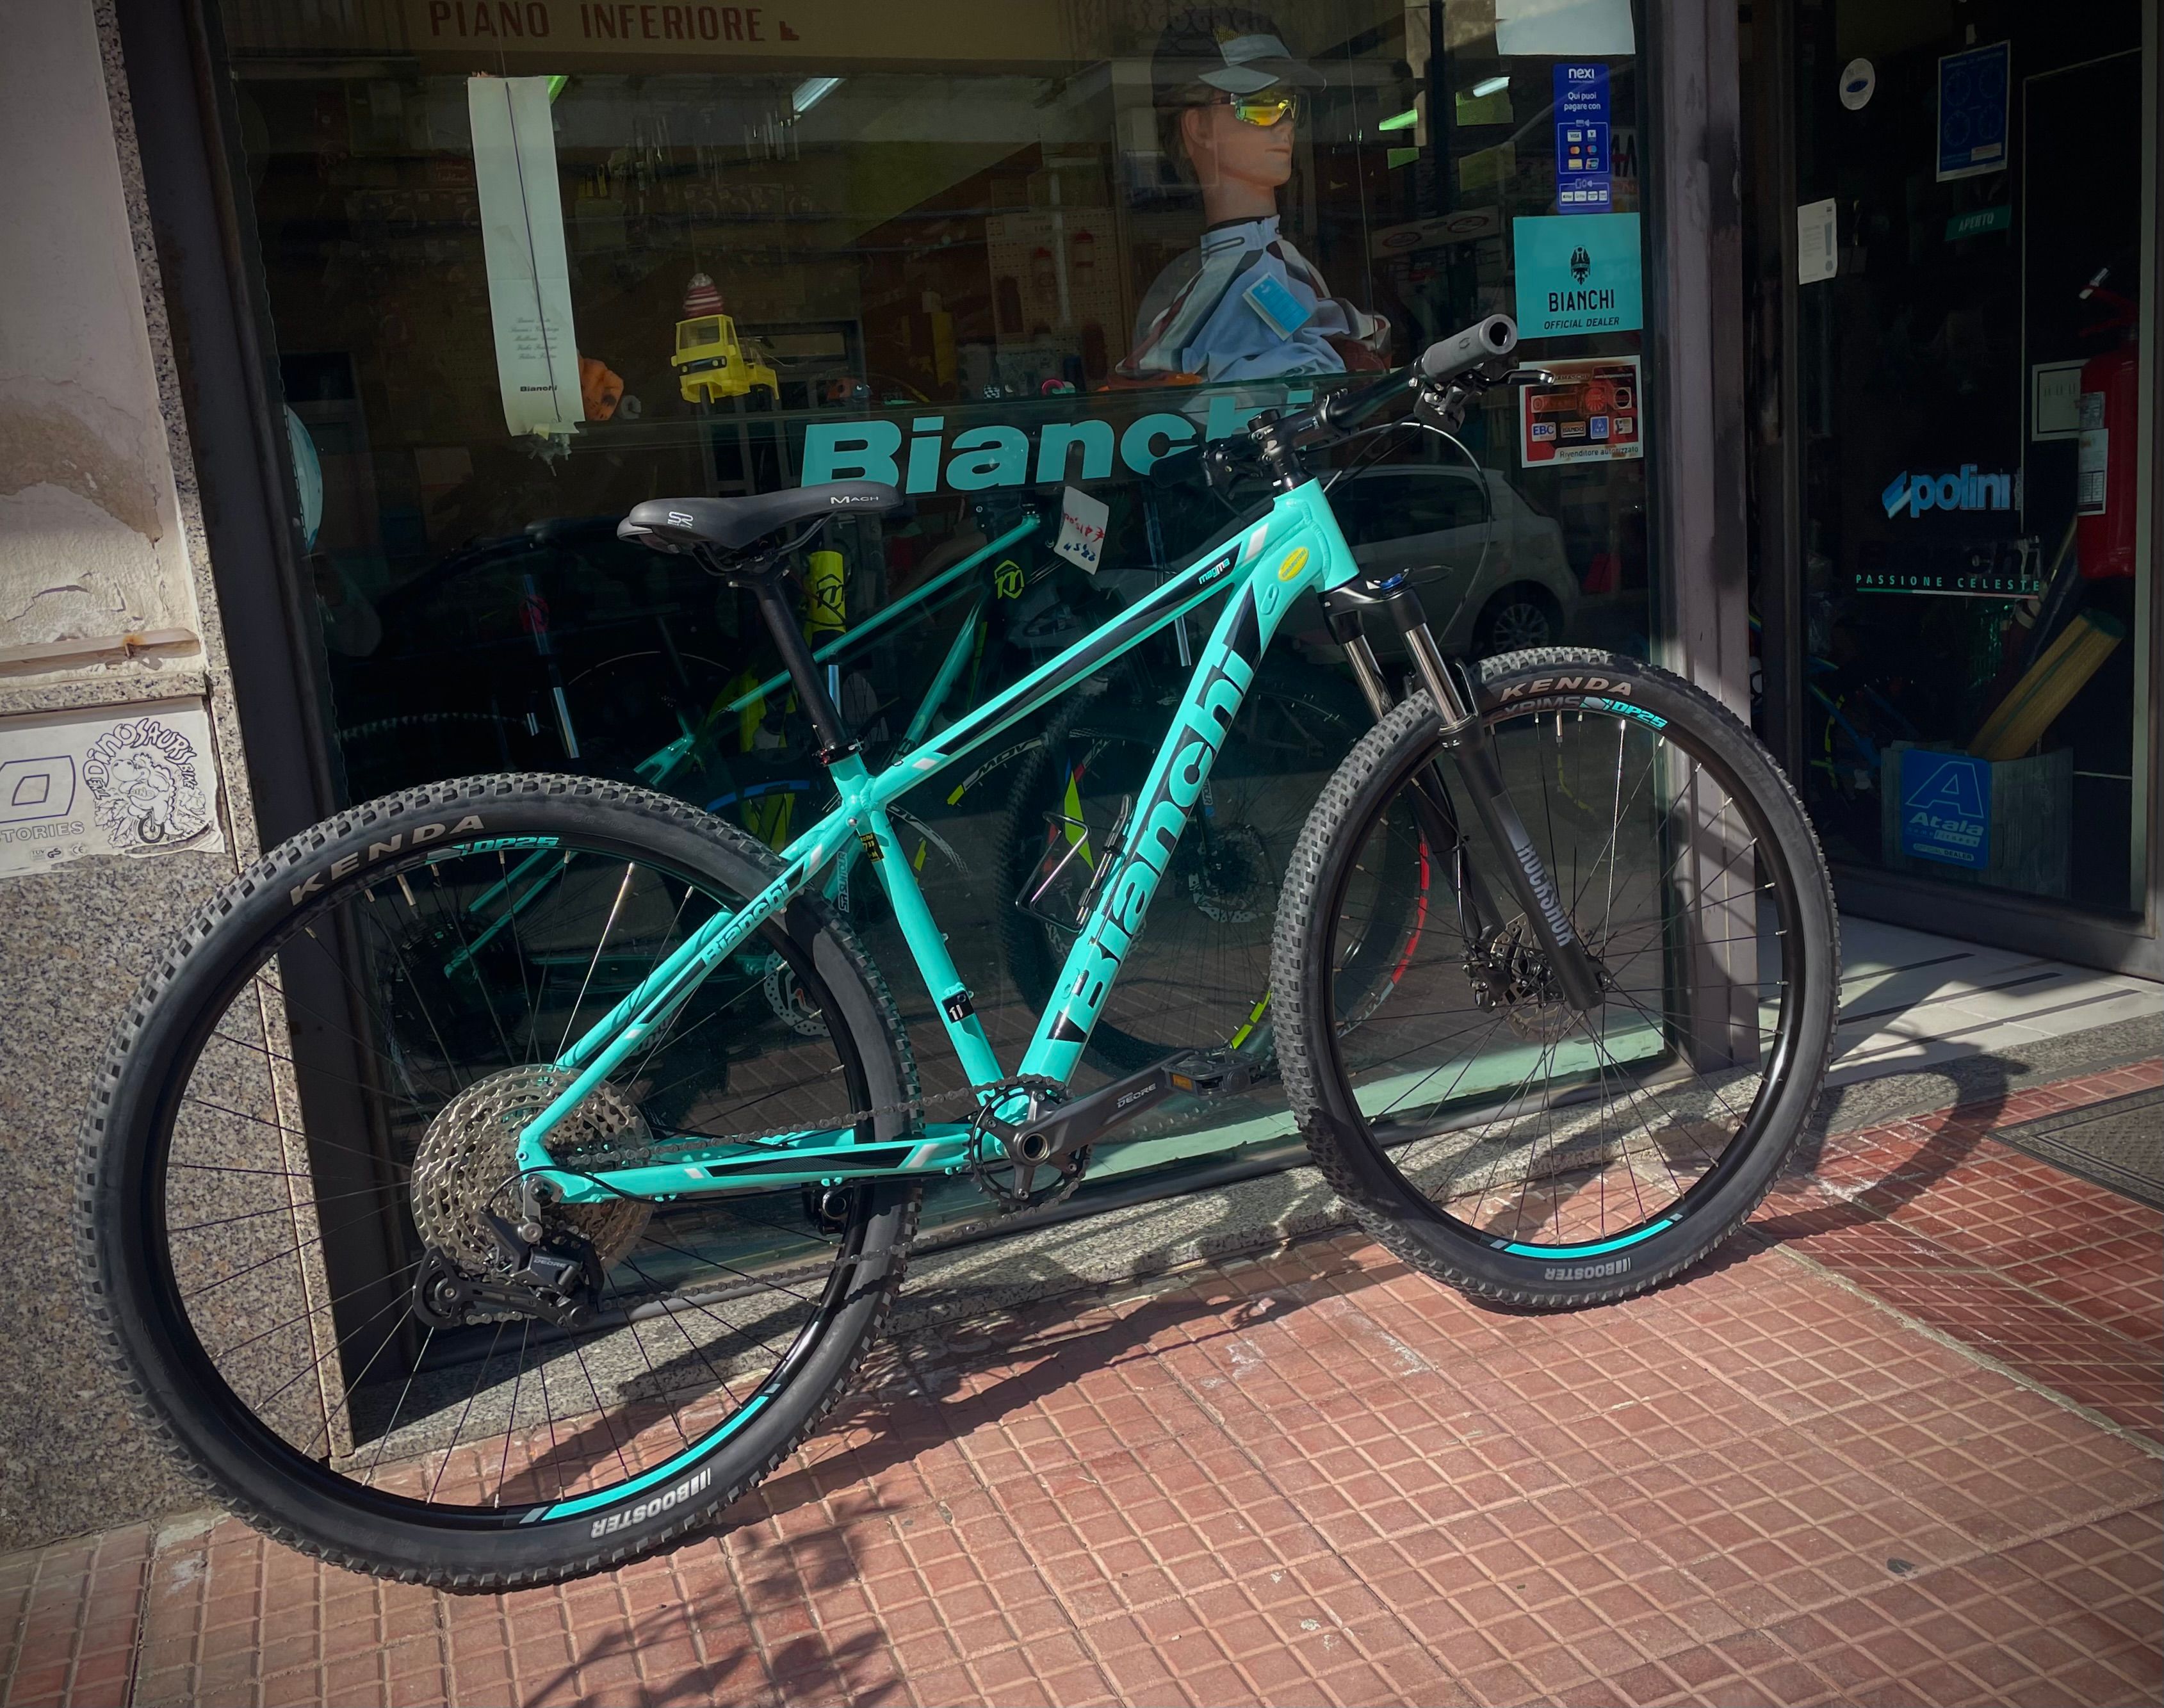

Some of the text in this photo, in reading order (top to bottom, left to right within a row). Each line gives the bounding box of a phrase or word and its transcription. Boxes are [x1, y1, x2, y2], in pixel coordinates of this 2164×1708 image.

[430, 1, 766, 42] PIANO INFERIORE
[1568, 68, 1595, 79] nexi
[1564, 104, 1587, 112] pagare
[1568, 92, 1597, 101] Qui puoi
[1958, 212, 1994, 232] APERTO
[1549, 289, 1615, 312] BIANCHI
[1544, 316, 1620, 330] OFFICIAL DEALER
[1533, 425, 1554, 435] EBC
[1559, 446, 1639, 458] Rivenditore autorizzato
[1910, 463, 2011, 518] polini
[1198, 558, 1230, 585] magma
[1855, 574, 2040, 592] PASSIONE CELESTE
[1499, 676, 1632, 703] KENDA
[1611, 702, 1669, 729] DP25
[177, 763, 199, 790] BIKE
[0, 821, 85, 843] TORIES
[1908, 811, 1985, 836] Atala
[471, 836, 559, 851] DP25
[1064, 644, 1255, 1032] Bianchi
[289, 815, 485, 907] KENDA
[1944, 849, 1972, 860] DEALER
[1517, 844, 1575, 947] ROCKSHOX
[701, 879, 790, 964] Bianchi
[1117, 1083, 1157, 1109] DEORE
[533, 1258, 567, 1268] DEORE
[1545, 1262, 1615, 1280] BOOSTER
[591, 1480, 690, 1538] BOOSTER
